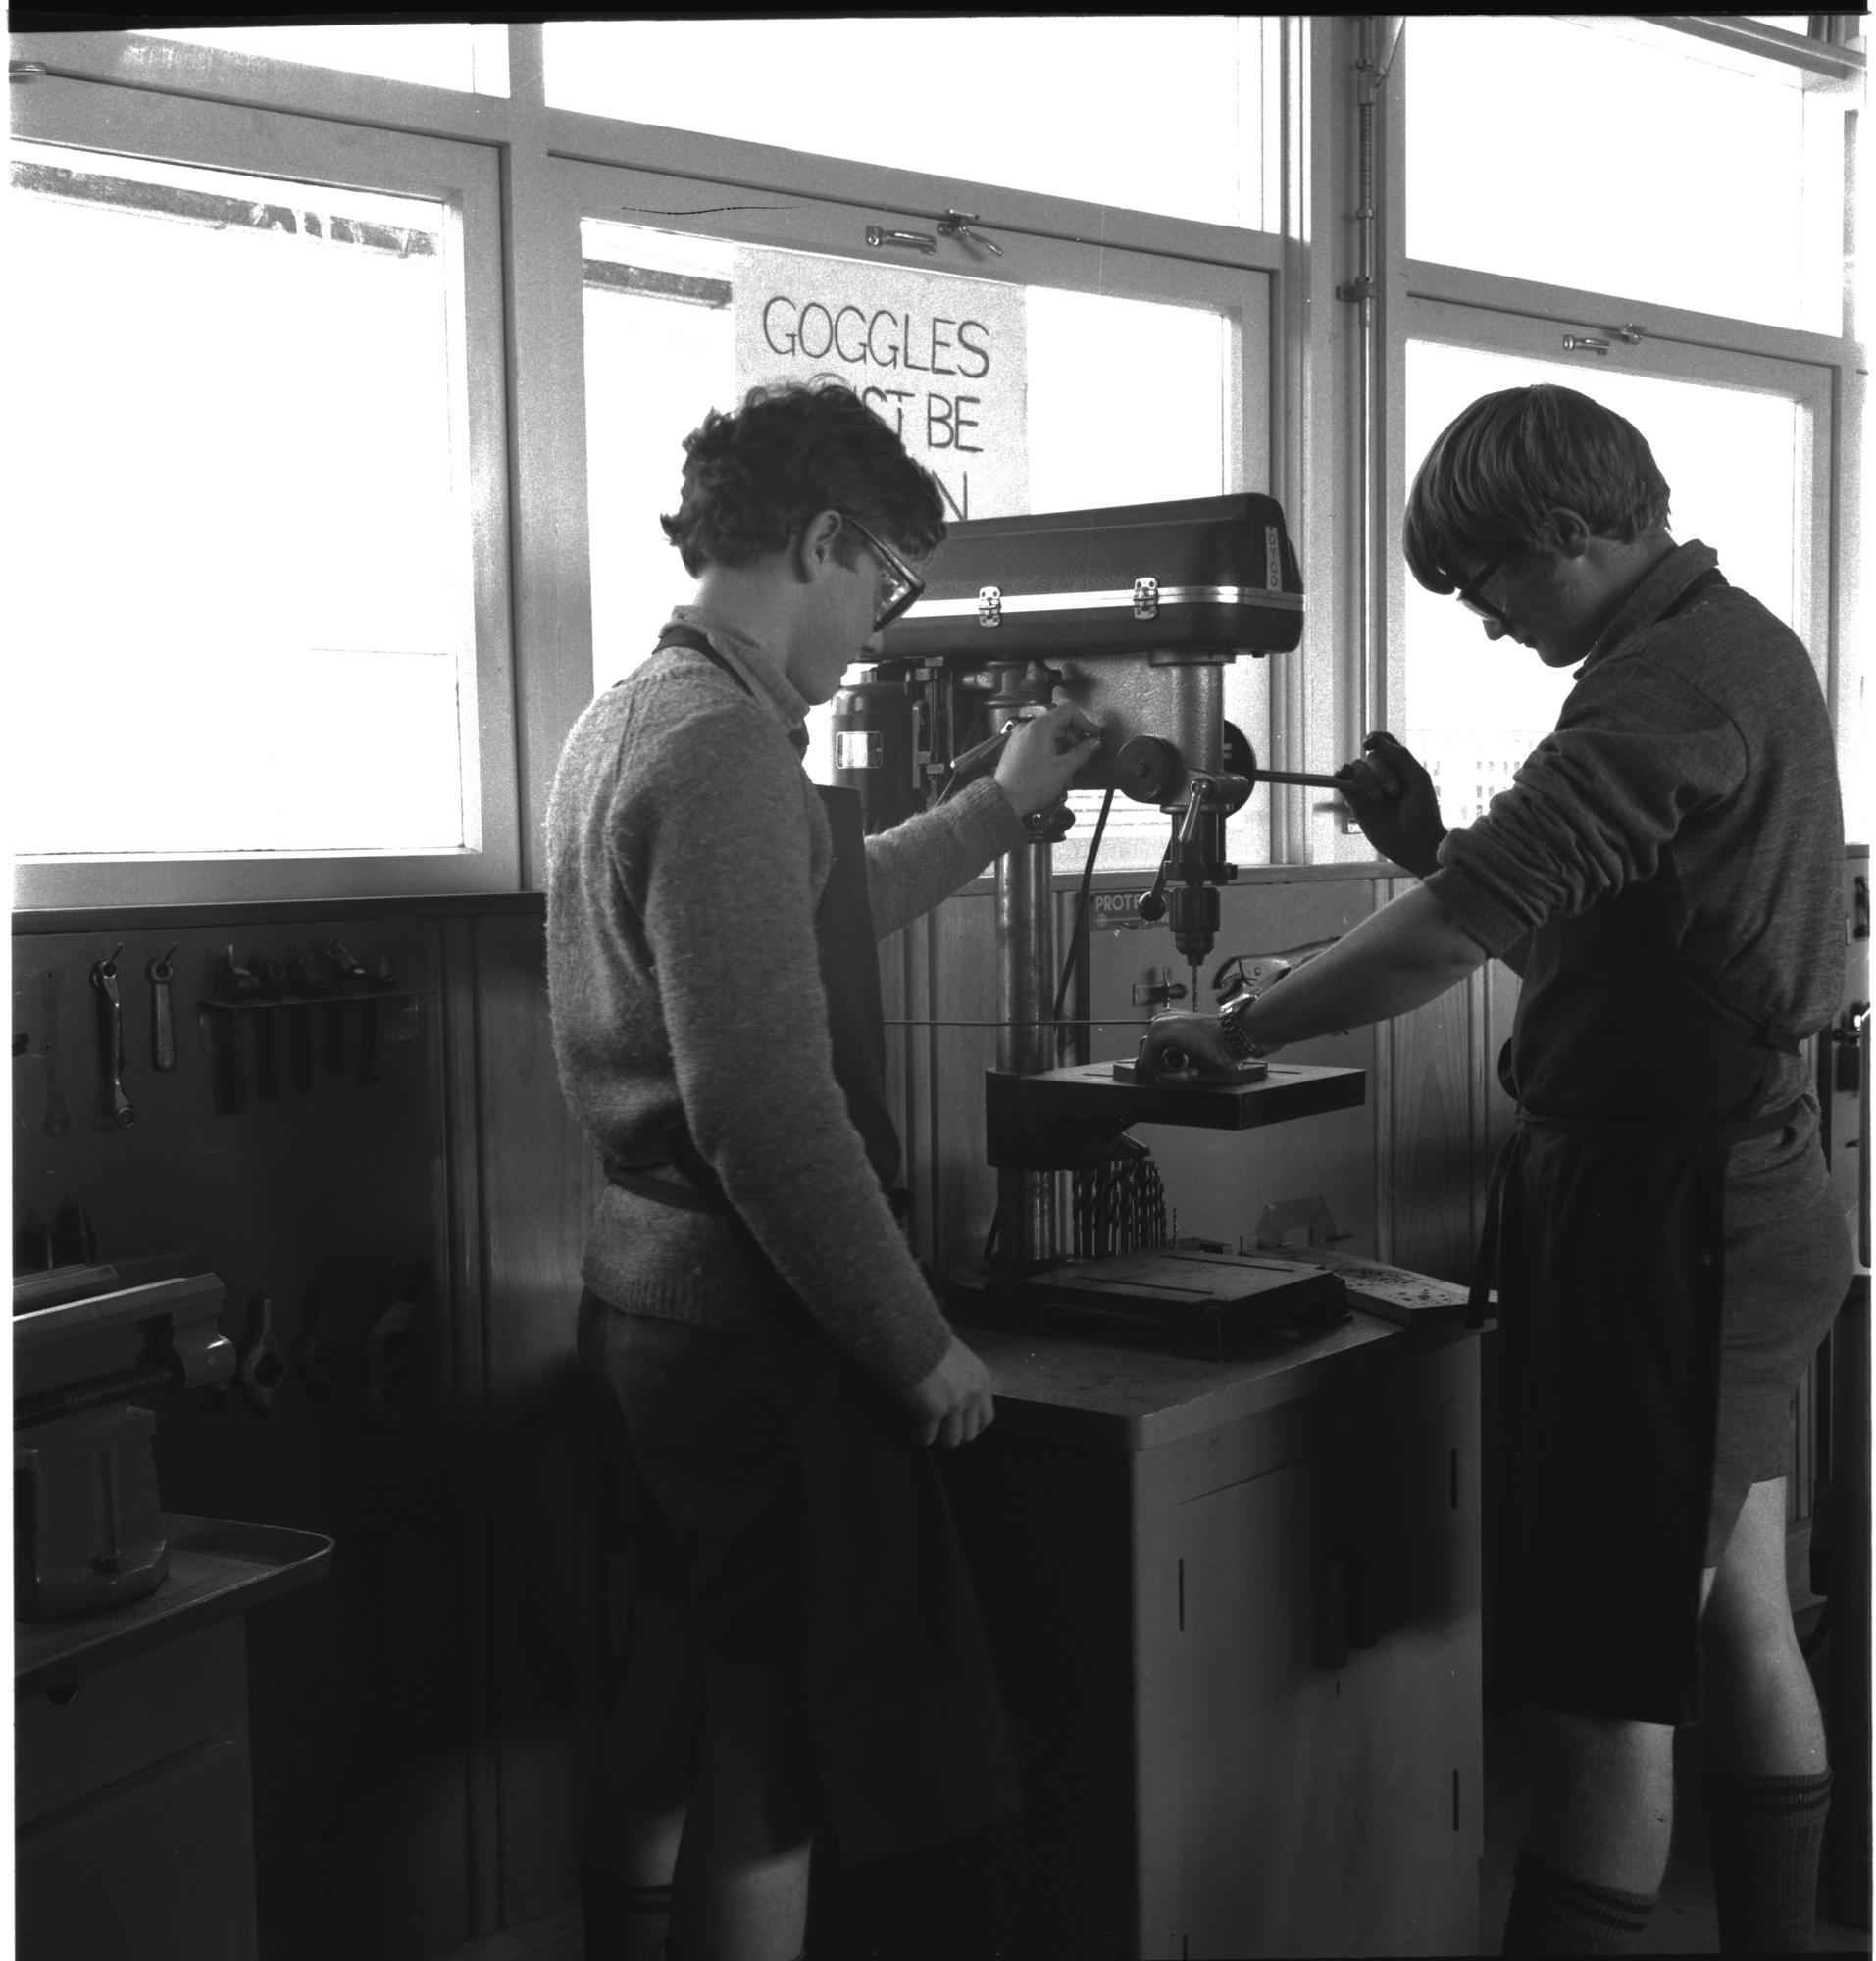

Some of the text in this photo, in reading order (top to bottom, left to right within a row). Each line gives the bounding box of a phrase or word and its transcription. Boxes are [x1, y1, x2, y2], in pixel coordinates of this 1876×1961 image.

[763, 295, 990, 379] GOGGLES
[927, 392, 985, 453] BE
[1269, 532, 1278, 587] DYCO
[1095, 893, 1141, 911] PROTE
